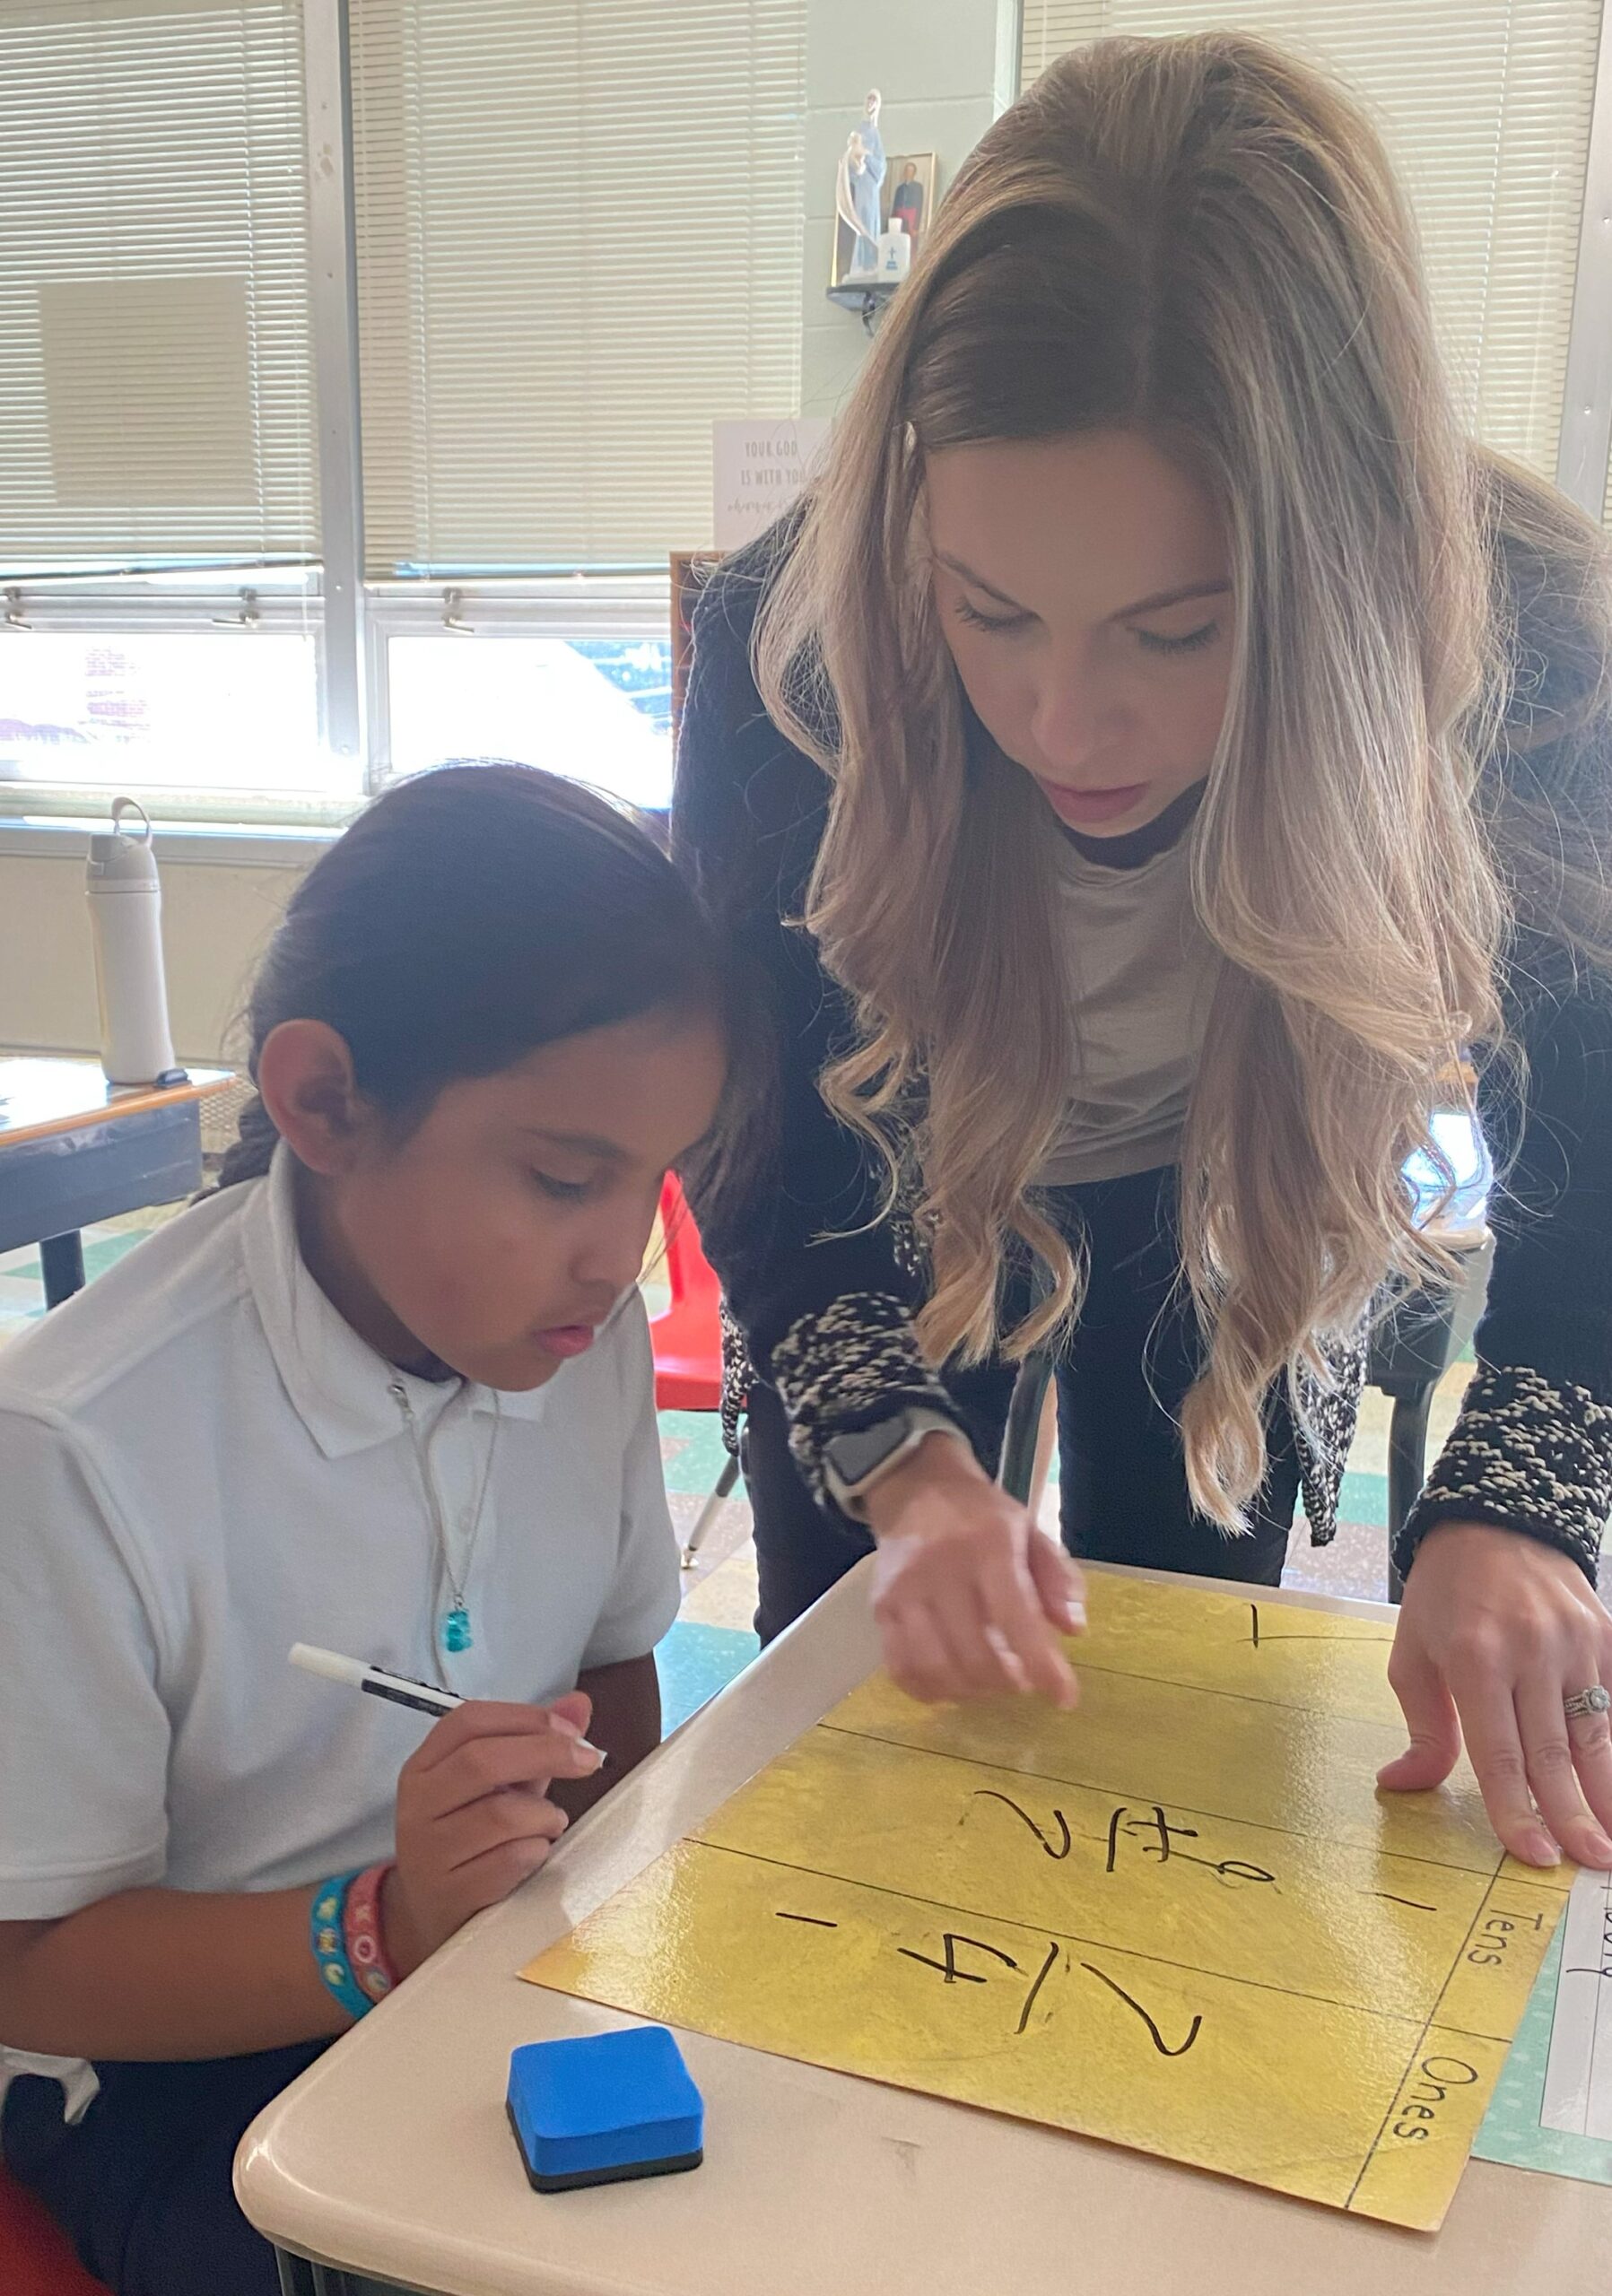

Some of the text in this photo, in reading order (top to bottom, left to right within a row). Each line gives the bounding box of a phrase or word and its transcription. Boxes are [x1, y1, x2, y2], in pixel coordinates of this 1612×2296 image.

[745, 440, 798, 457] YOUR GOD
[741, 469, 752, 485] IS
[755, 469, 782, 485] WITH
[1467, 1909, 1544, 1967] Tens
[1392, 2056, 1479, 2142] Ones
